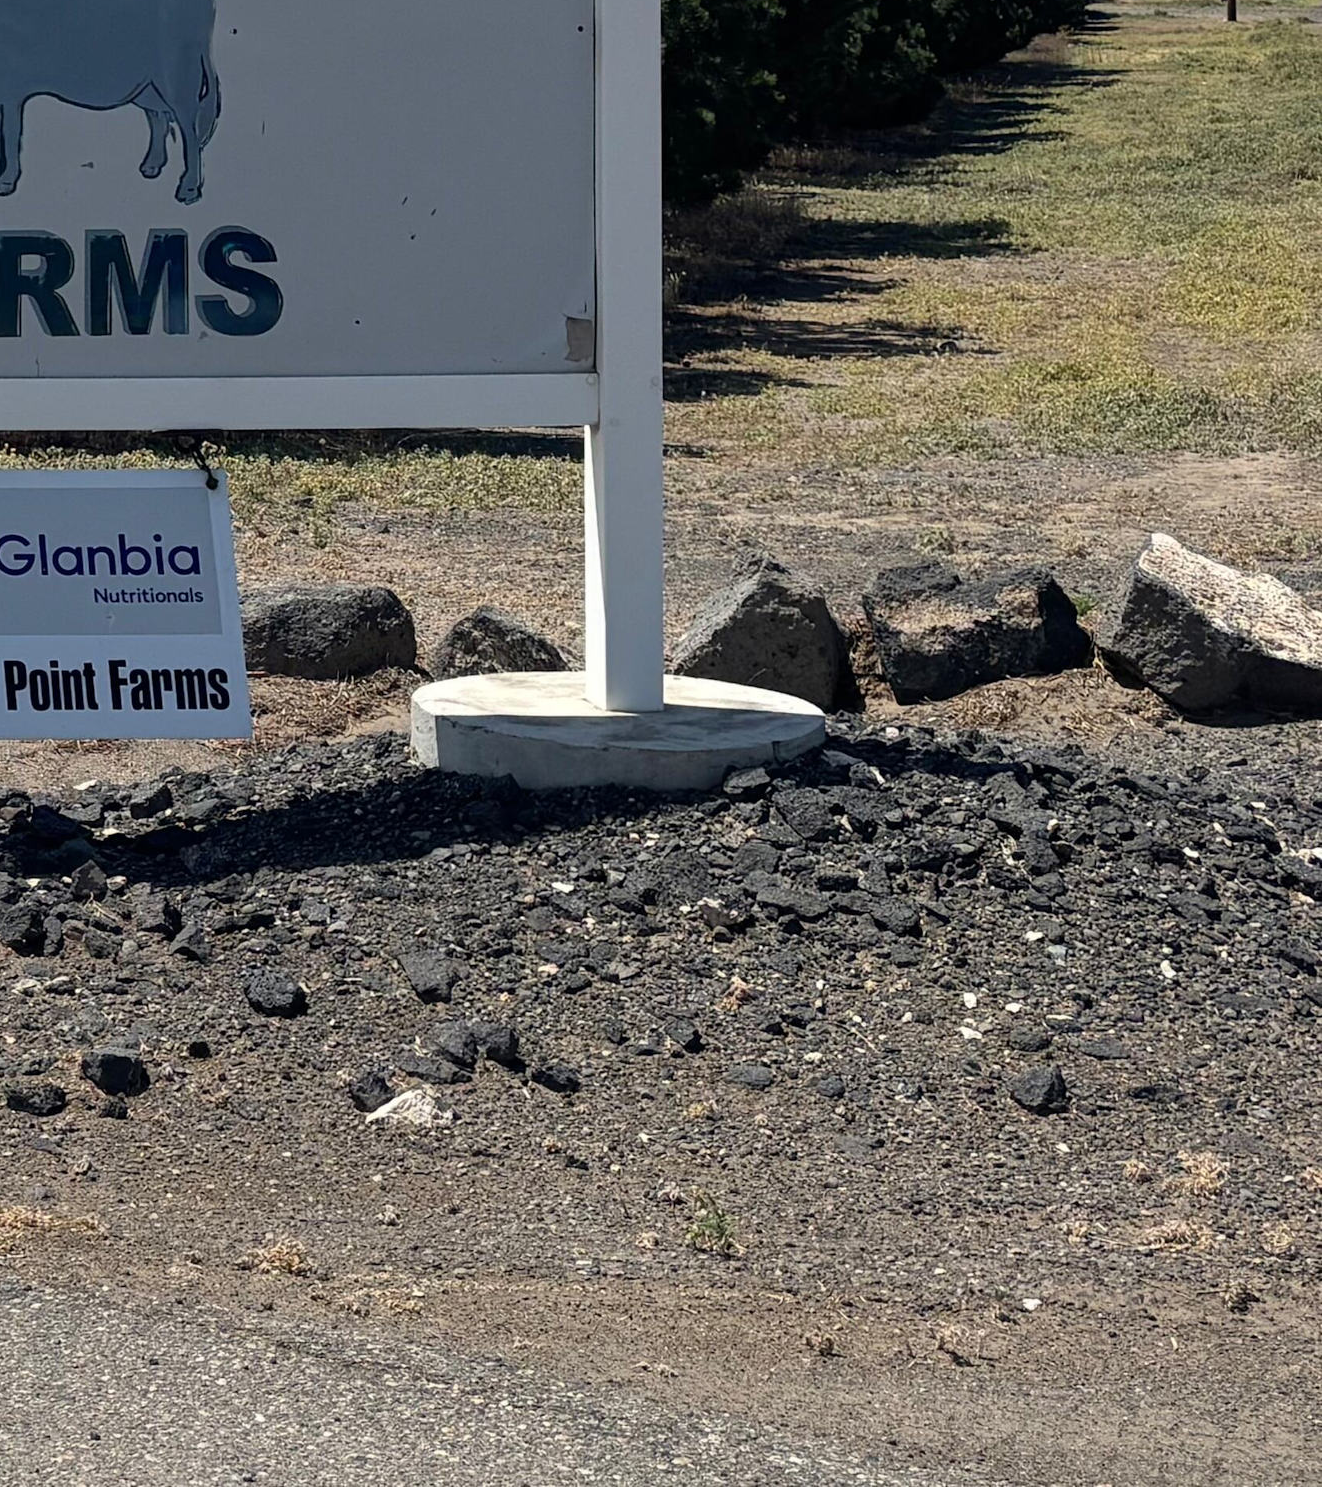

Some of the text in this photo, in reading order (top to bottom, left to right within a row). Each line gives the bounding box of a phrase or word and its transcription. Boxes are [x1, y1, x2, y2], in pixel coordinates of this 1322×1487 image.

[93, 587, 204, 604] Nutritionals
[4, 659, 99, 711] Point
[108, 659, 231, 711] Farms
